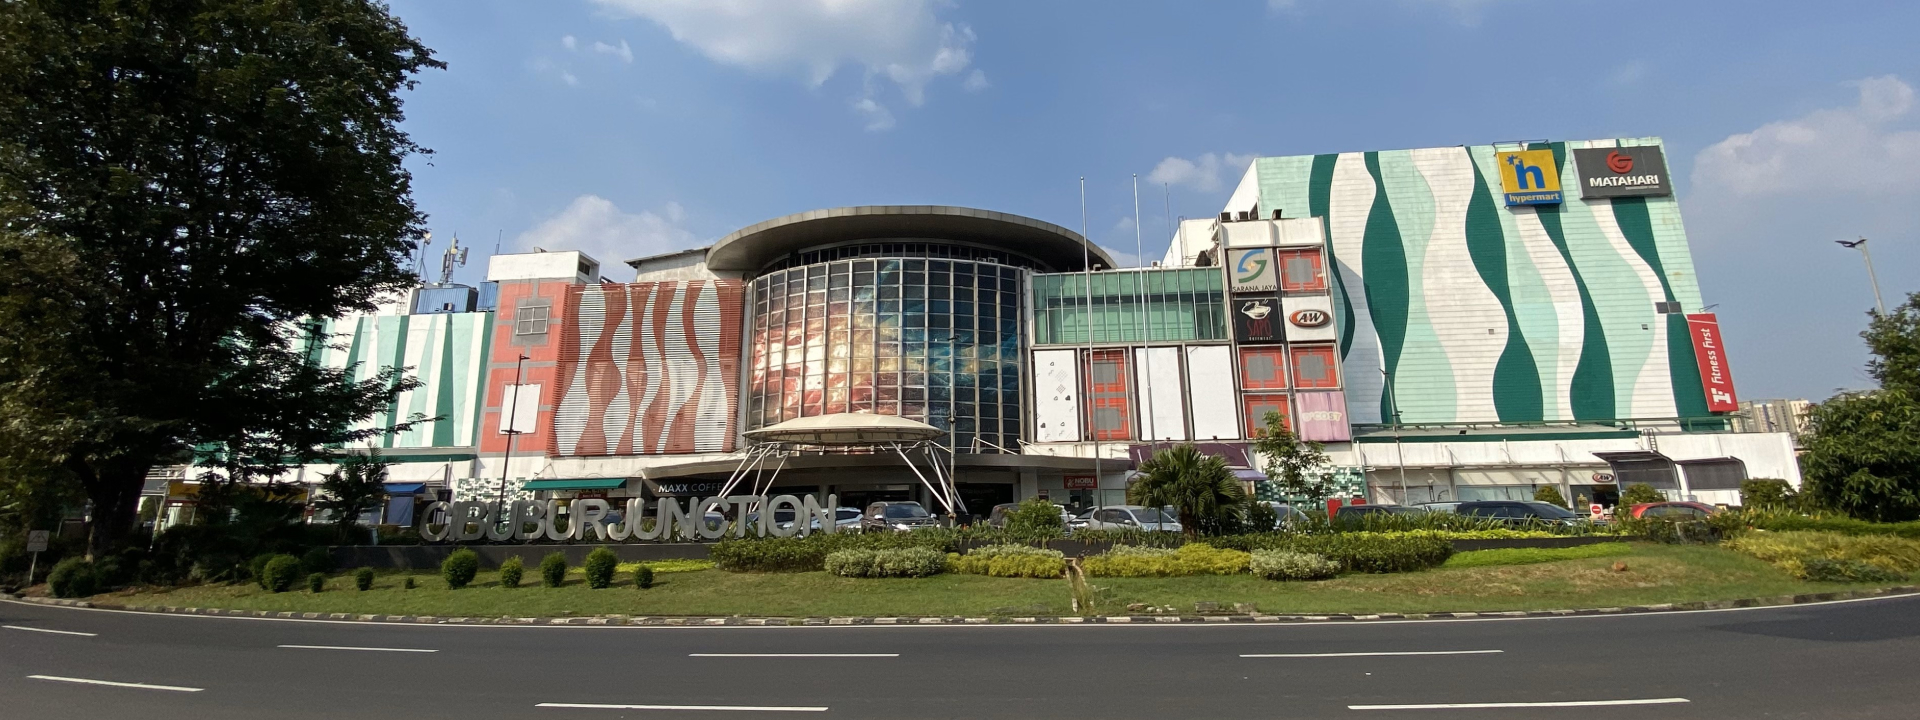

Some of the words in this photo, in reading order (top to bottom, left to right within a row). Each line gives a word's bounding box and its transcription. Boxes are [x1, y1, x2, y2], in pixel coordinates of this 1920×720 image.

[1589, 174, 1660, 187] MATAHARI
[1508, 193, 1560, 203] hypermart
[658, 484, 688, 493] MAXX
